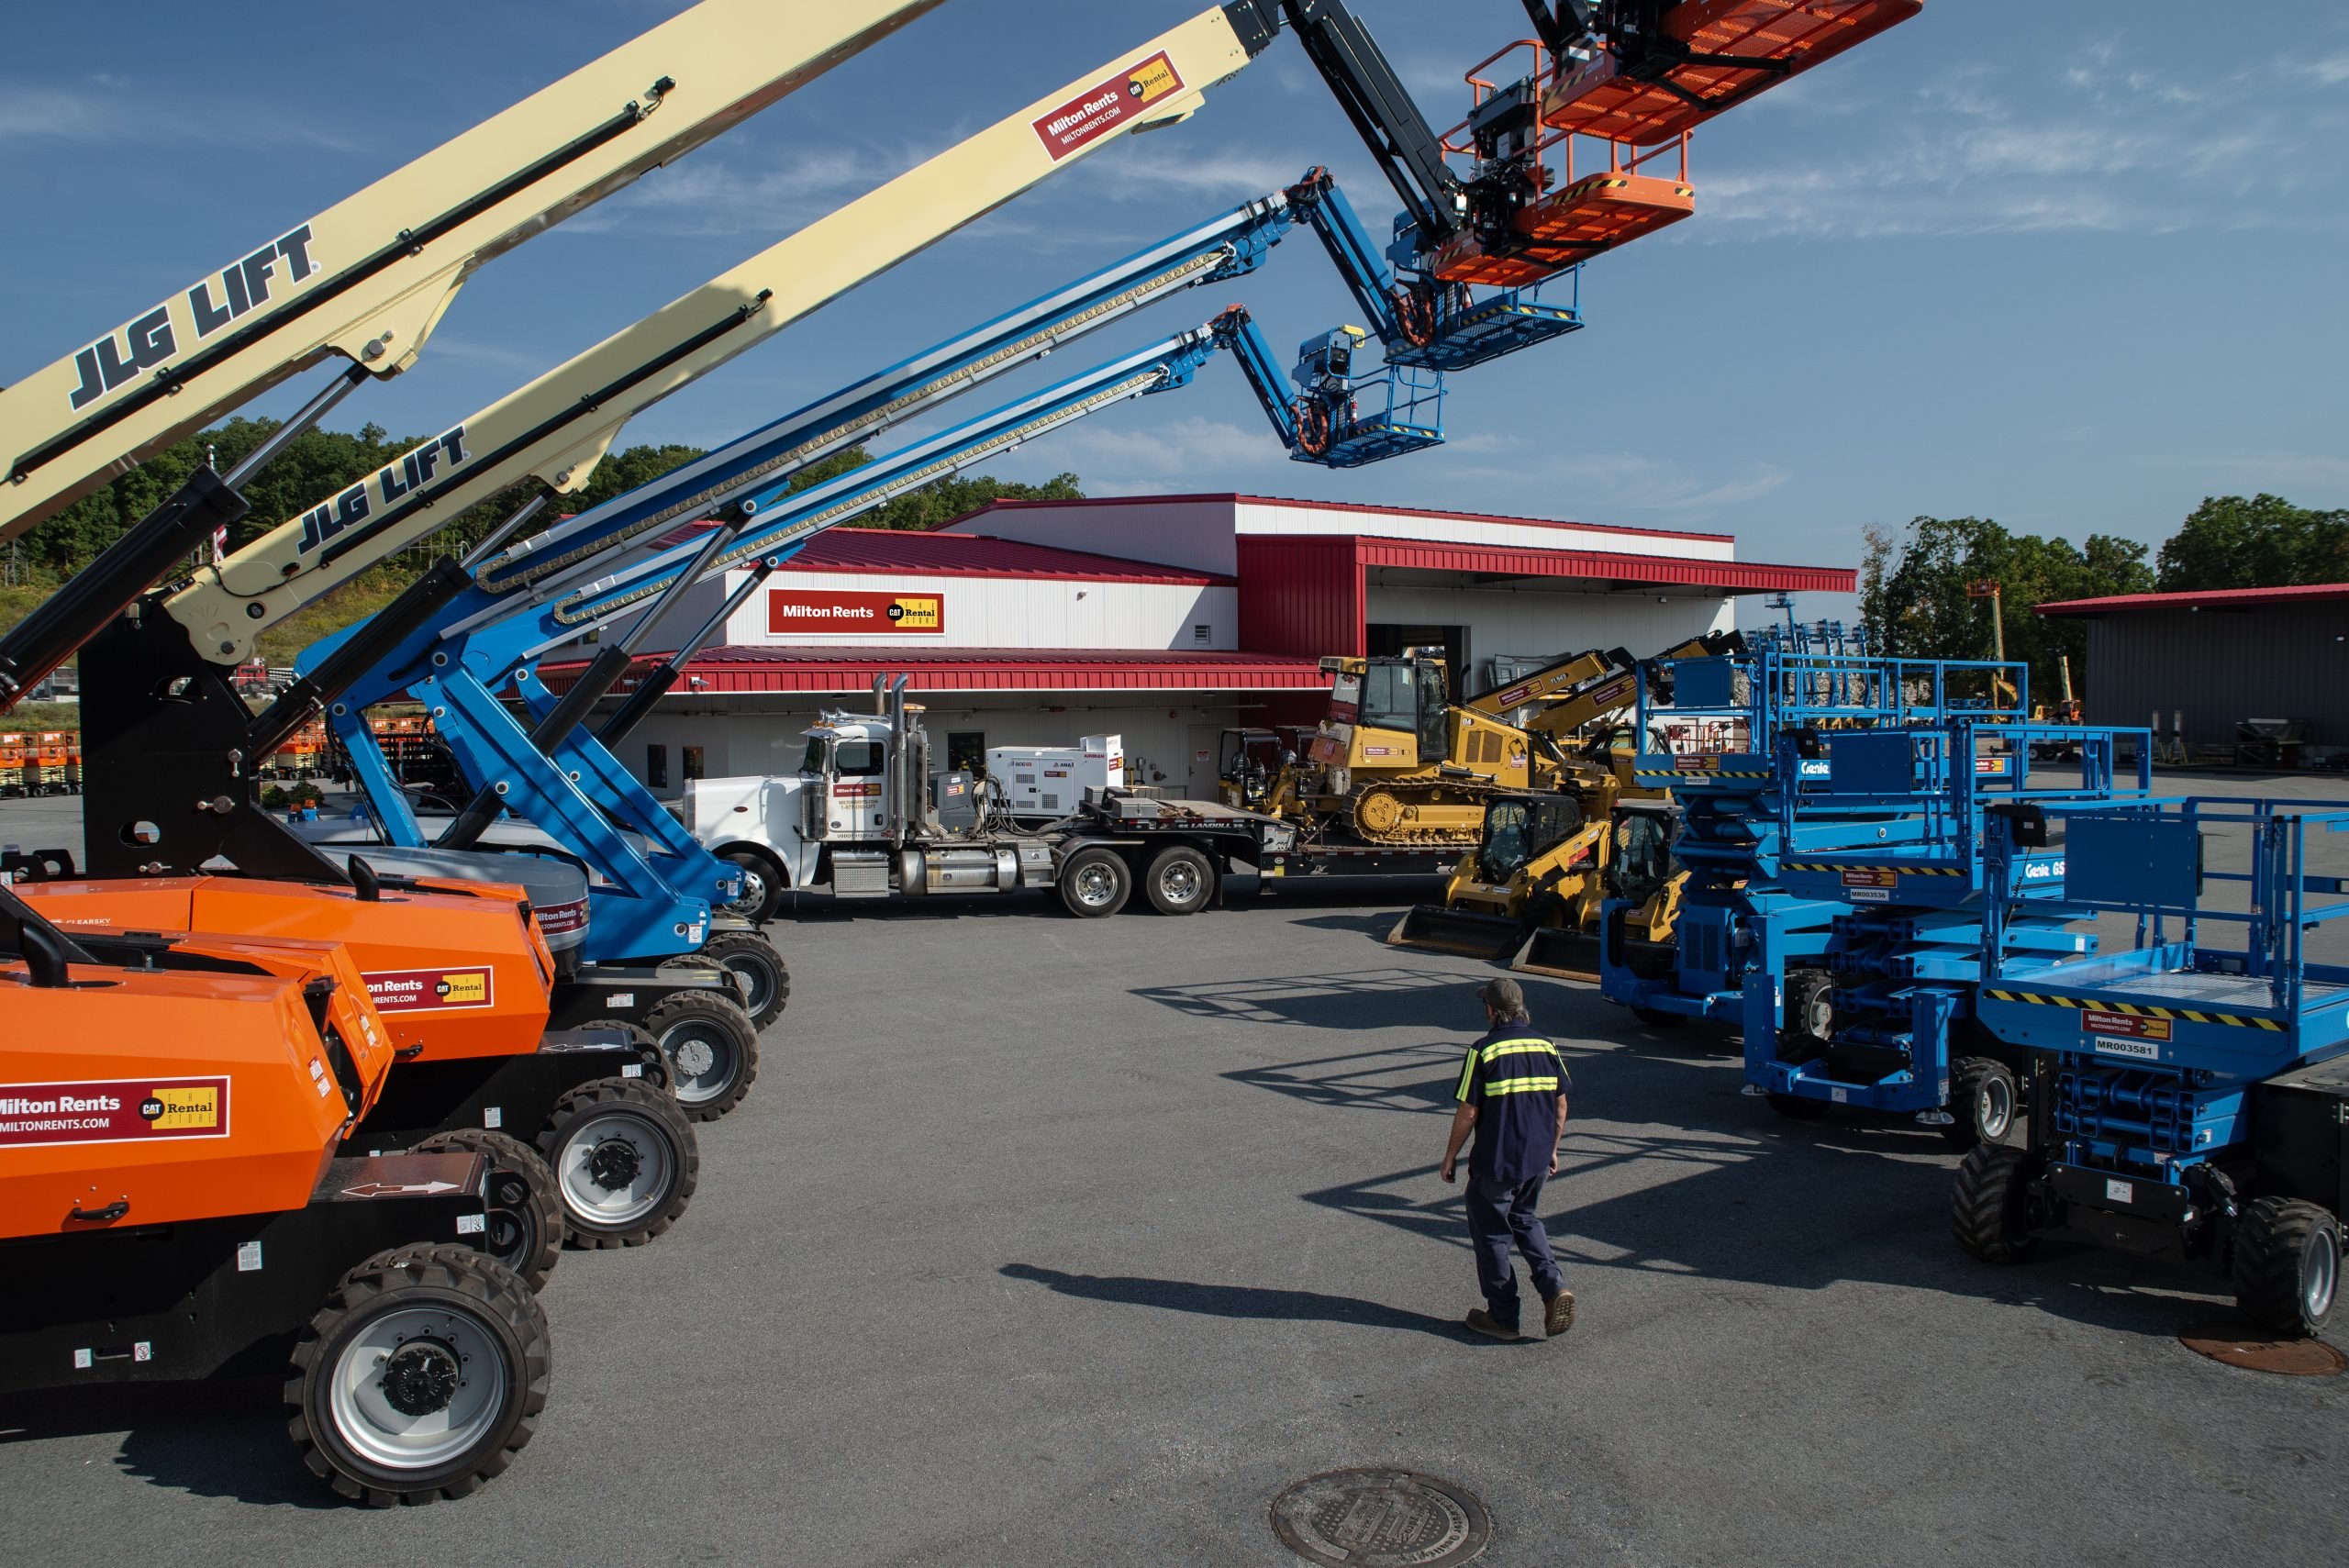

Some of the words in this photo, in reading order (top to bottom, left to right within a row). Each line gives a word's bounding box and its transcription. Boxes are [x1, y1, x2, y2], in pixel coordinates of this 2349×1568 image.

[1142, 69, 1168, 88] Rental
[1130, 83, 1141, 95] CAT
[1047, 107, 1086, 137] Milton
[1084, 91, 1119, 117] Rents
[1061, 106, 1121, 145] MILTONRENTS.COM
[69, 305, 179, 413] JLG
[188, 222, 313, 340] LIFT
[297, 481, 372, 556] JLG
[379, 424, 466, 506] LIFT
[783, 606, 830, 617] Milton
[832, 606, 874, 617] Rents
[1801, 762, 1829, 773] Genie
[2025, 862, 2050, 878] Genie
[559, 908, 576, 918] Rents
[384, 980, 423, 992] Rents
[452, 983, 482, 991] Rental
[373, 994, 417, 1004] RENTS.COM
[2087, 1014, 2111, 1023] Milton
[2111, 1017, 2133, 1026] Rents
[2097, 1040, 2152, 1055] MR003581
[60, 1095, 120, 1112] Rents
[142, 1104, 161, 1115] CAT
[167, 1102, 213, 1114] Rental
[0, 1118, 109, 1132] MILTONRENTS.COM
